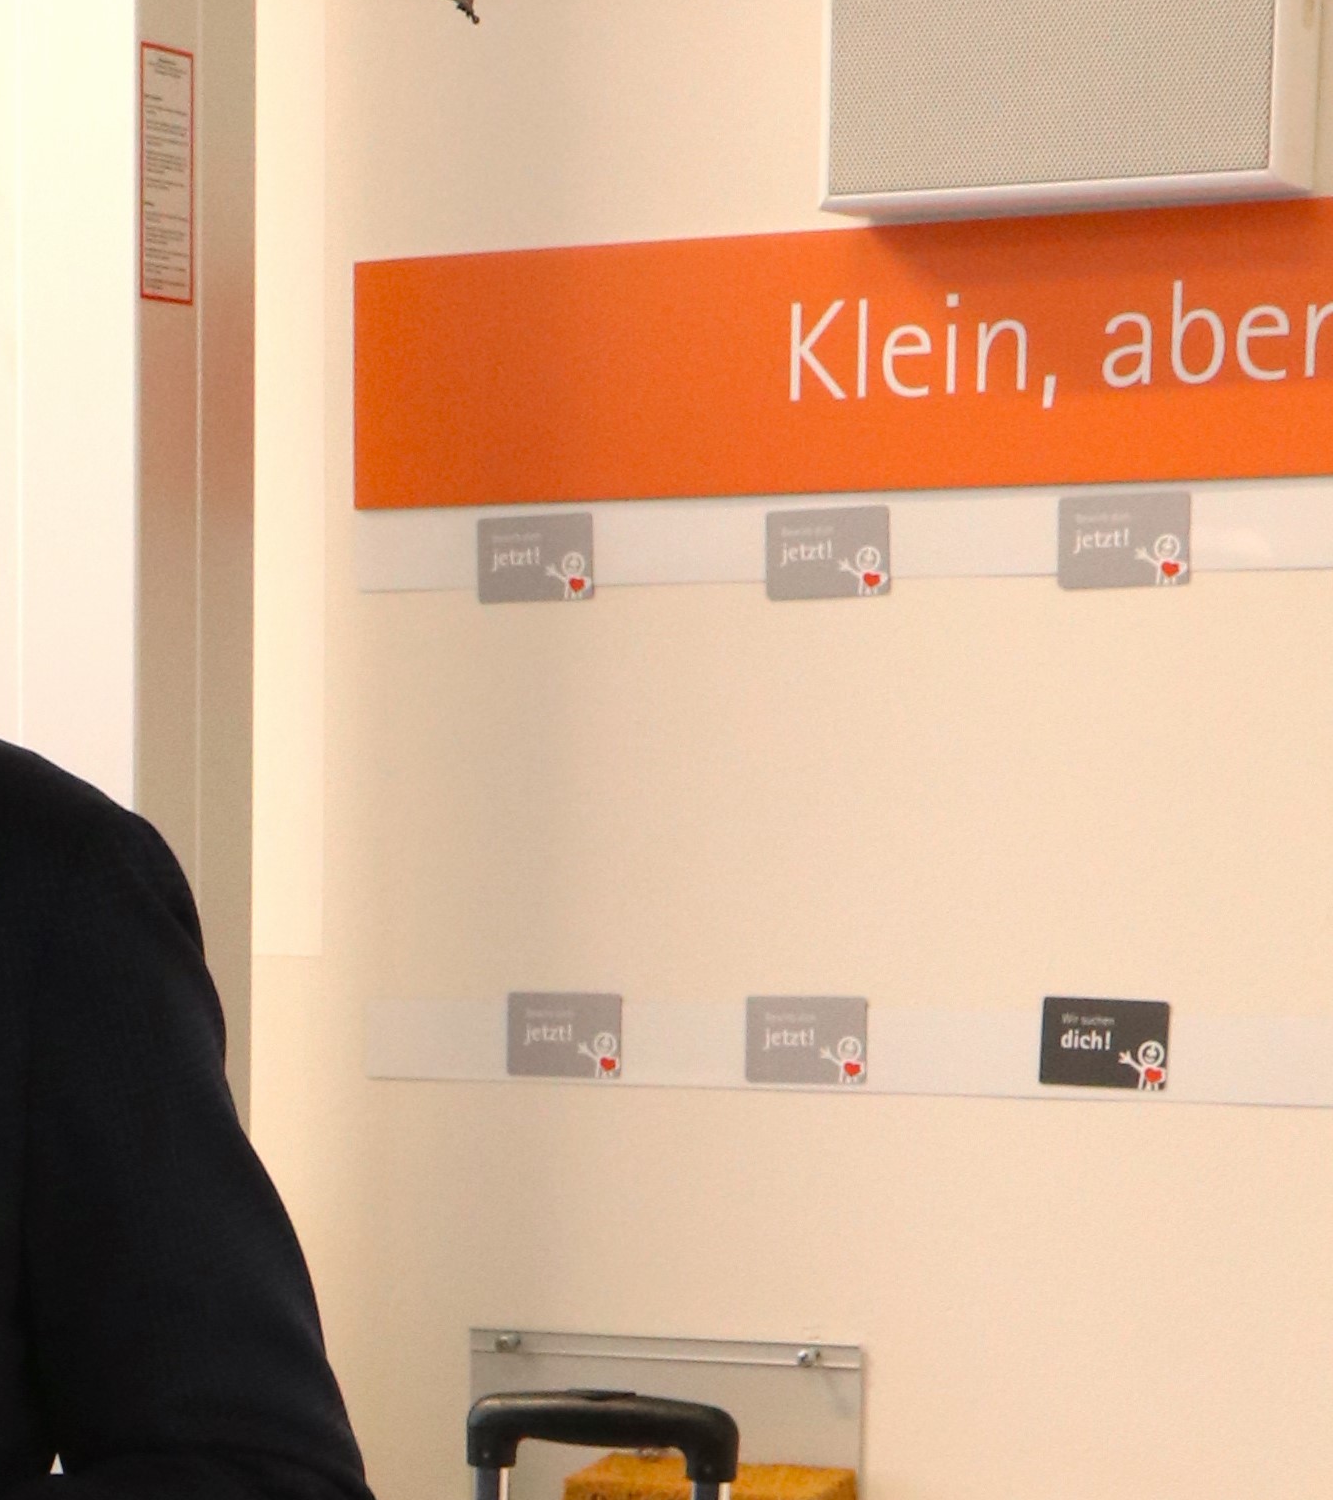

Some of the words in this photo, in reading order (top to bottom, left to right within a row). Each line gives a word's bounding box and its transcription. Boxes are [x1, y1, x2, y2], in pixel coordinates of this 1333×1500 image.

[789, 292, 1057, 410] Klein,
[1100, 279, 1333, 389] aber
[1073, 527, 1130, 555] jetzt!
[1060, 1028, 1112, 1051] dich!
